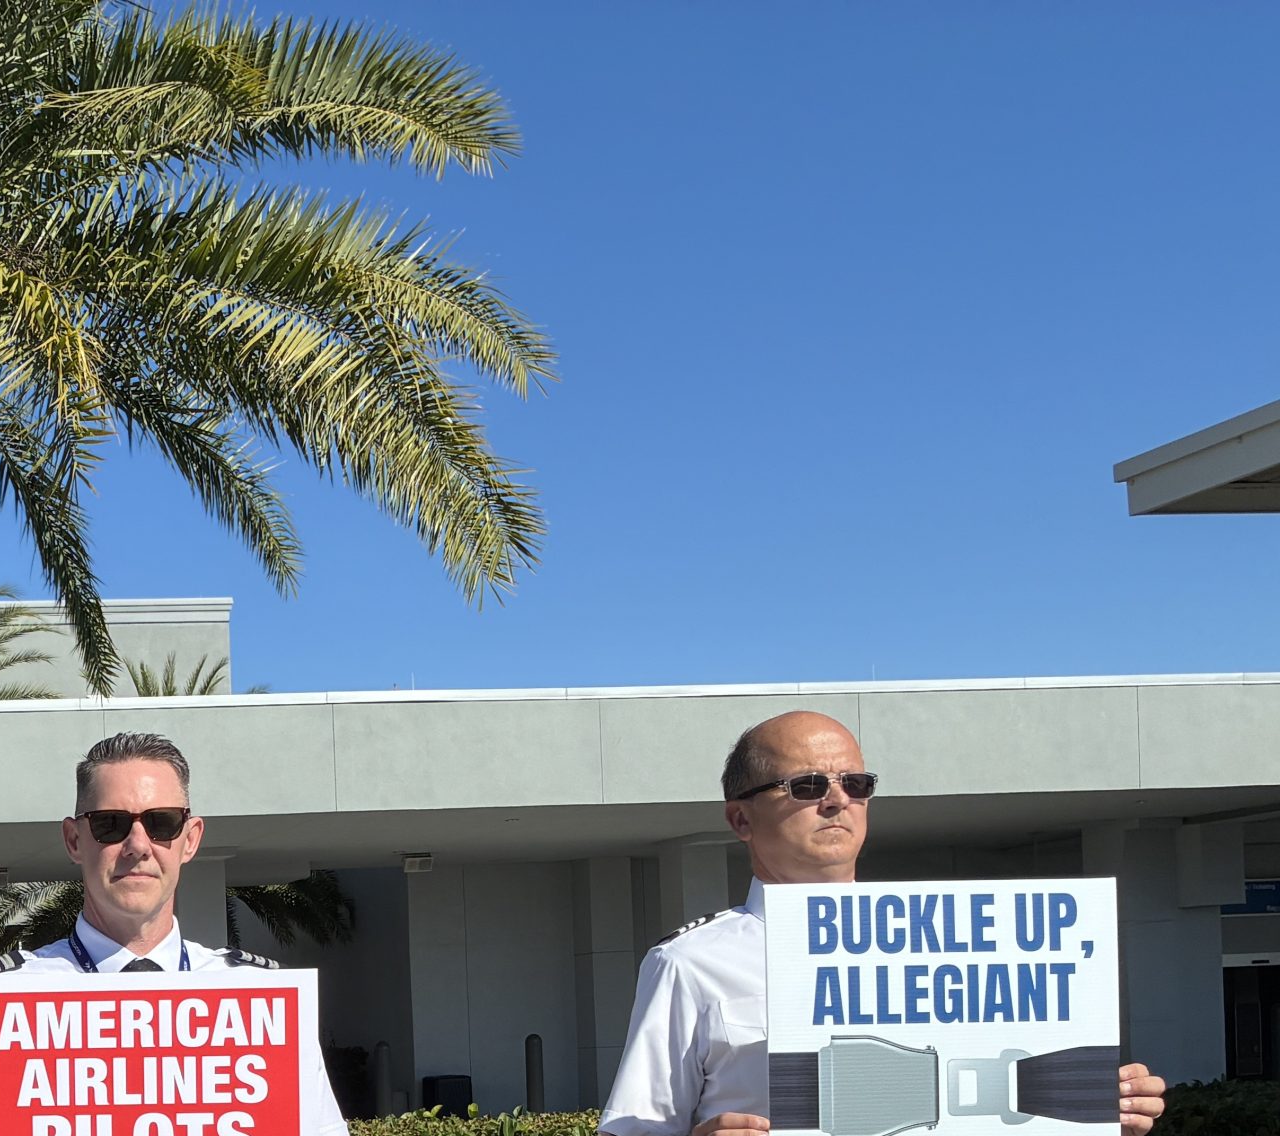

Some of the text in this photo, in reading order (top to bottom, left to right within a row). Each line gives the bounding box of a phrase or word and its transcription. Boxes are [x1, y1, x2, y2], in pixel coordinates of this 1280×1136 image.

[808, 894, 1094, 958] BUCKLE UP,
[814, 963, 1076, 1025] ALLEGIANT
[16, 1055, 269, 1107] AIRLINES
